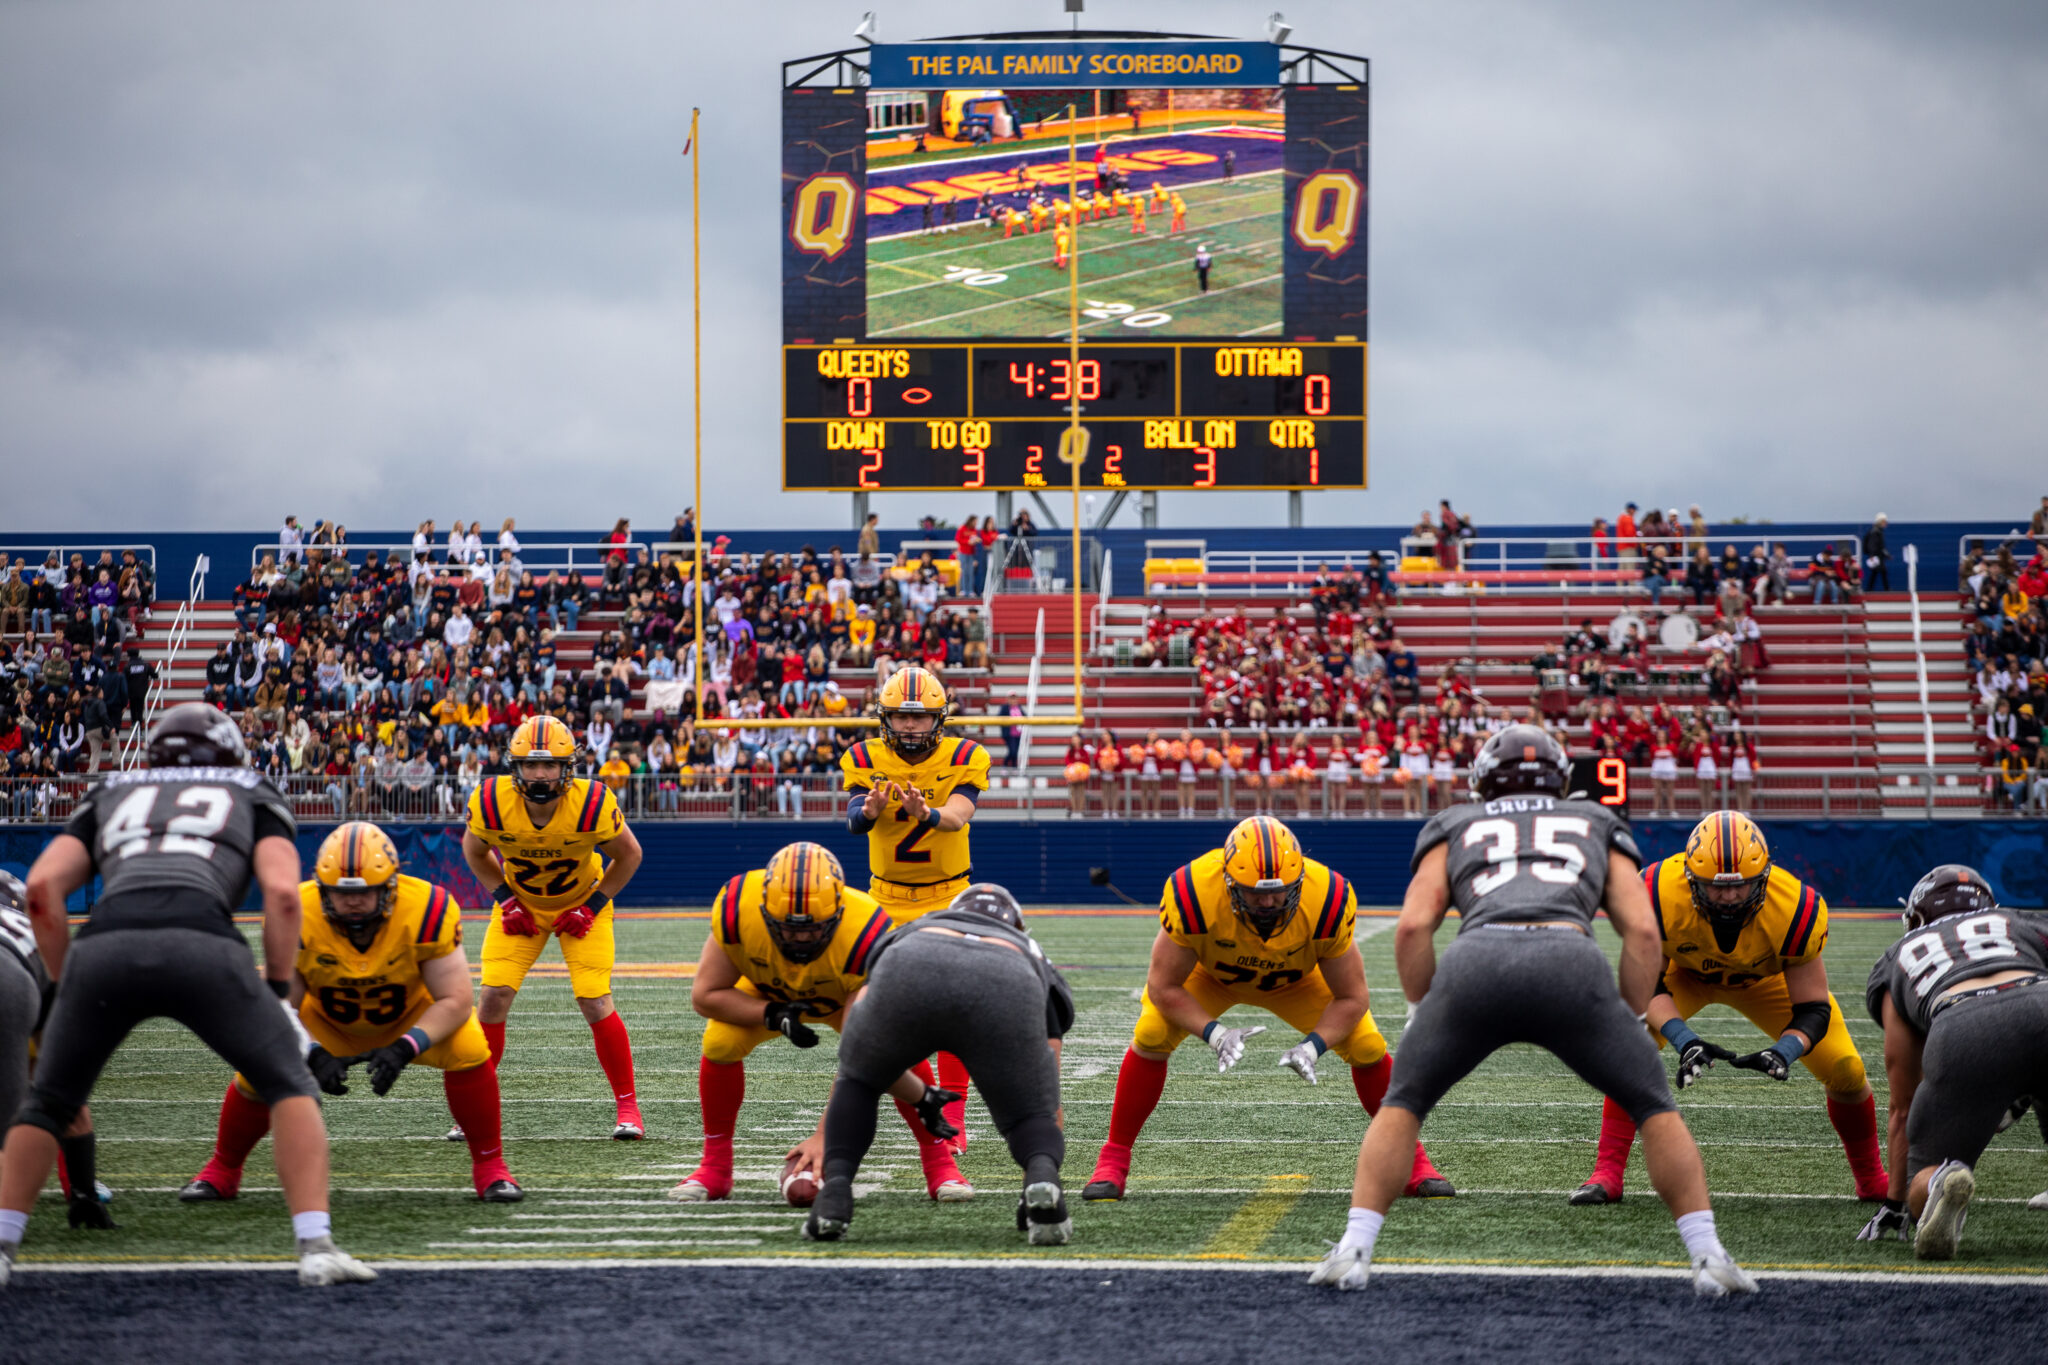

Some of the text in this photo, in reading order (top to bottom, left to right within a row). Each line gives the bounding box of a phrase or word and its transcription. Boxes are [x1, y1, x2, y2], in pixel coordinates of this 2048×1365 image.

[908, 54, 1243, 75] THE PAL FAMILY SCOREBOARD
[789, 172, 861, 263] Q
[1290, 169, 1366, 260] Q
[817, 350, 910, 378] QUEEN'S
[1009, 359, 1101, 400] 4:38
[1215, 348, 1303, 376] OTTAWA
[848, 377, 871, 417] 0
[1304, 374, 1330, 415] 0
[827, 421, 885, 450] DOWN
[926, 421, 991, 449] TO GO
[1144, 420, 1236, 449] BALL ON
[1269, 420, 1316, 448] QTR
[859, 448, 883, 488] 2
[963, 448, 985, 488] 3
[1026, 445, 1043, 472] 2
[1104, 445, 1122, 472] 2
[1193, 447, 1216, 487] 3
[1310, 449, 1319, 485] 1
[1597, 757, 1626, 805] 9
[102, 785, 233, 859] 42
[895, 806, 931, 863] 2
[520, 848, 562, 859] QUEEN'S
[1462, 816, 1592, 897] 35
[507, 857, 580, 896] 22
[1898, 913, 2020, 999] 98
[319, 984, 407, 1025] 63
